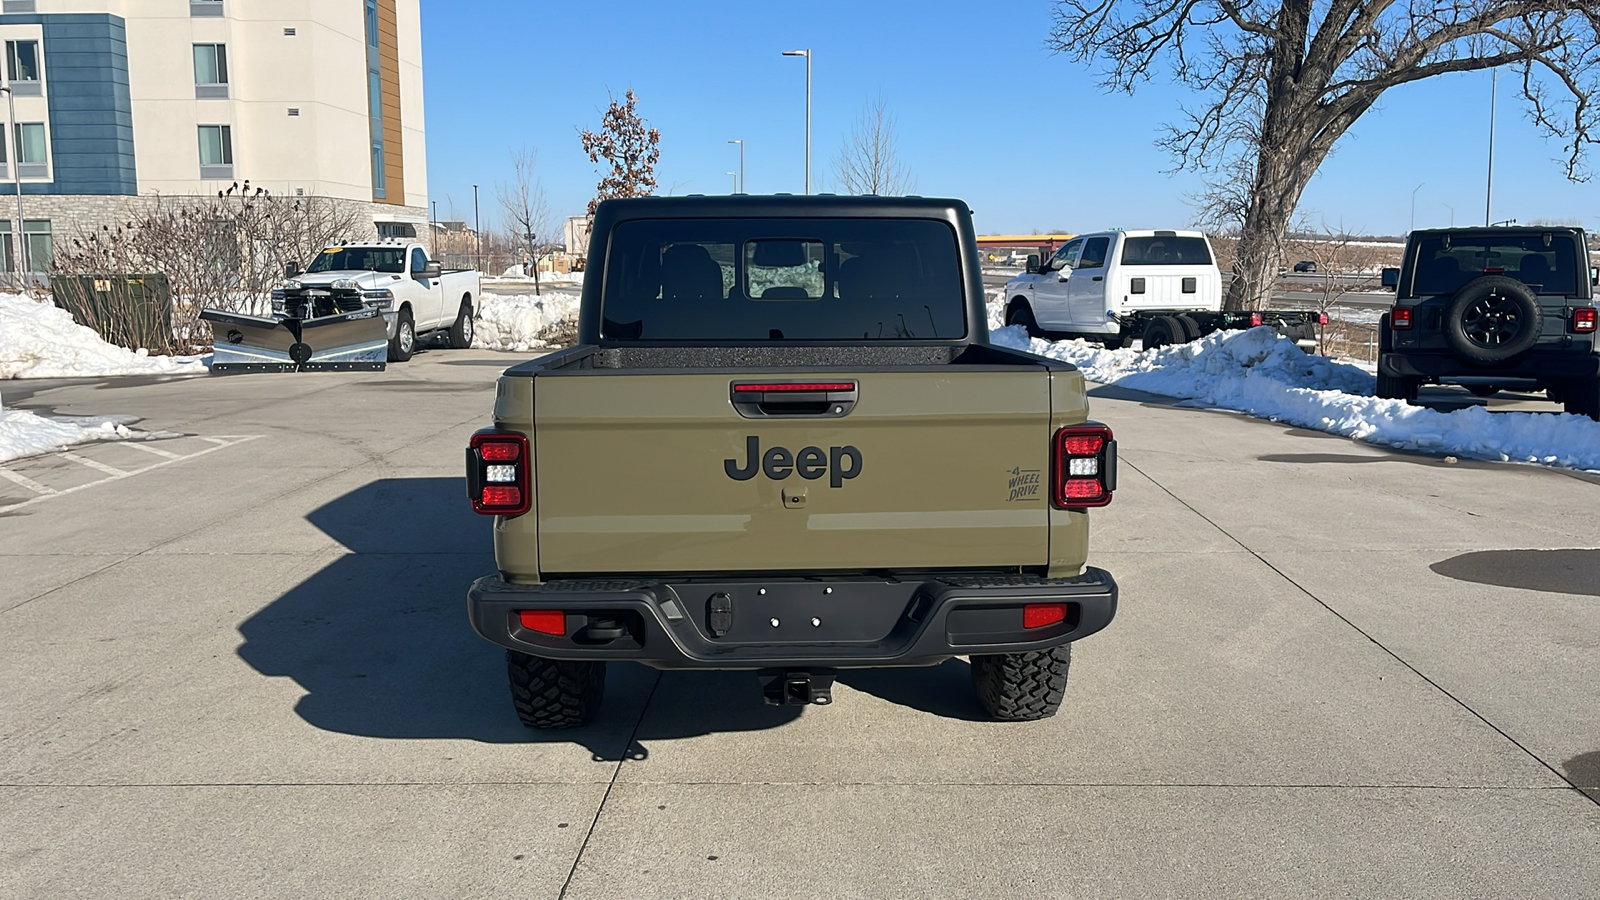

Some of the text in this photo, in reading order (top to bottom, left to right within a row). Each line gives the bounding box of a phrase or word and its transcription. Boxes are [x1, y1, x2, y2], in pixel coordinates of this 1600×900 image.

[724, 436, 863, 488] Jeep
[1012, 466, 1020, 475] 4
[1008, 473, 1040, 489] WHEEL
[1009, 485, 1039, 502] DRIVE
